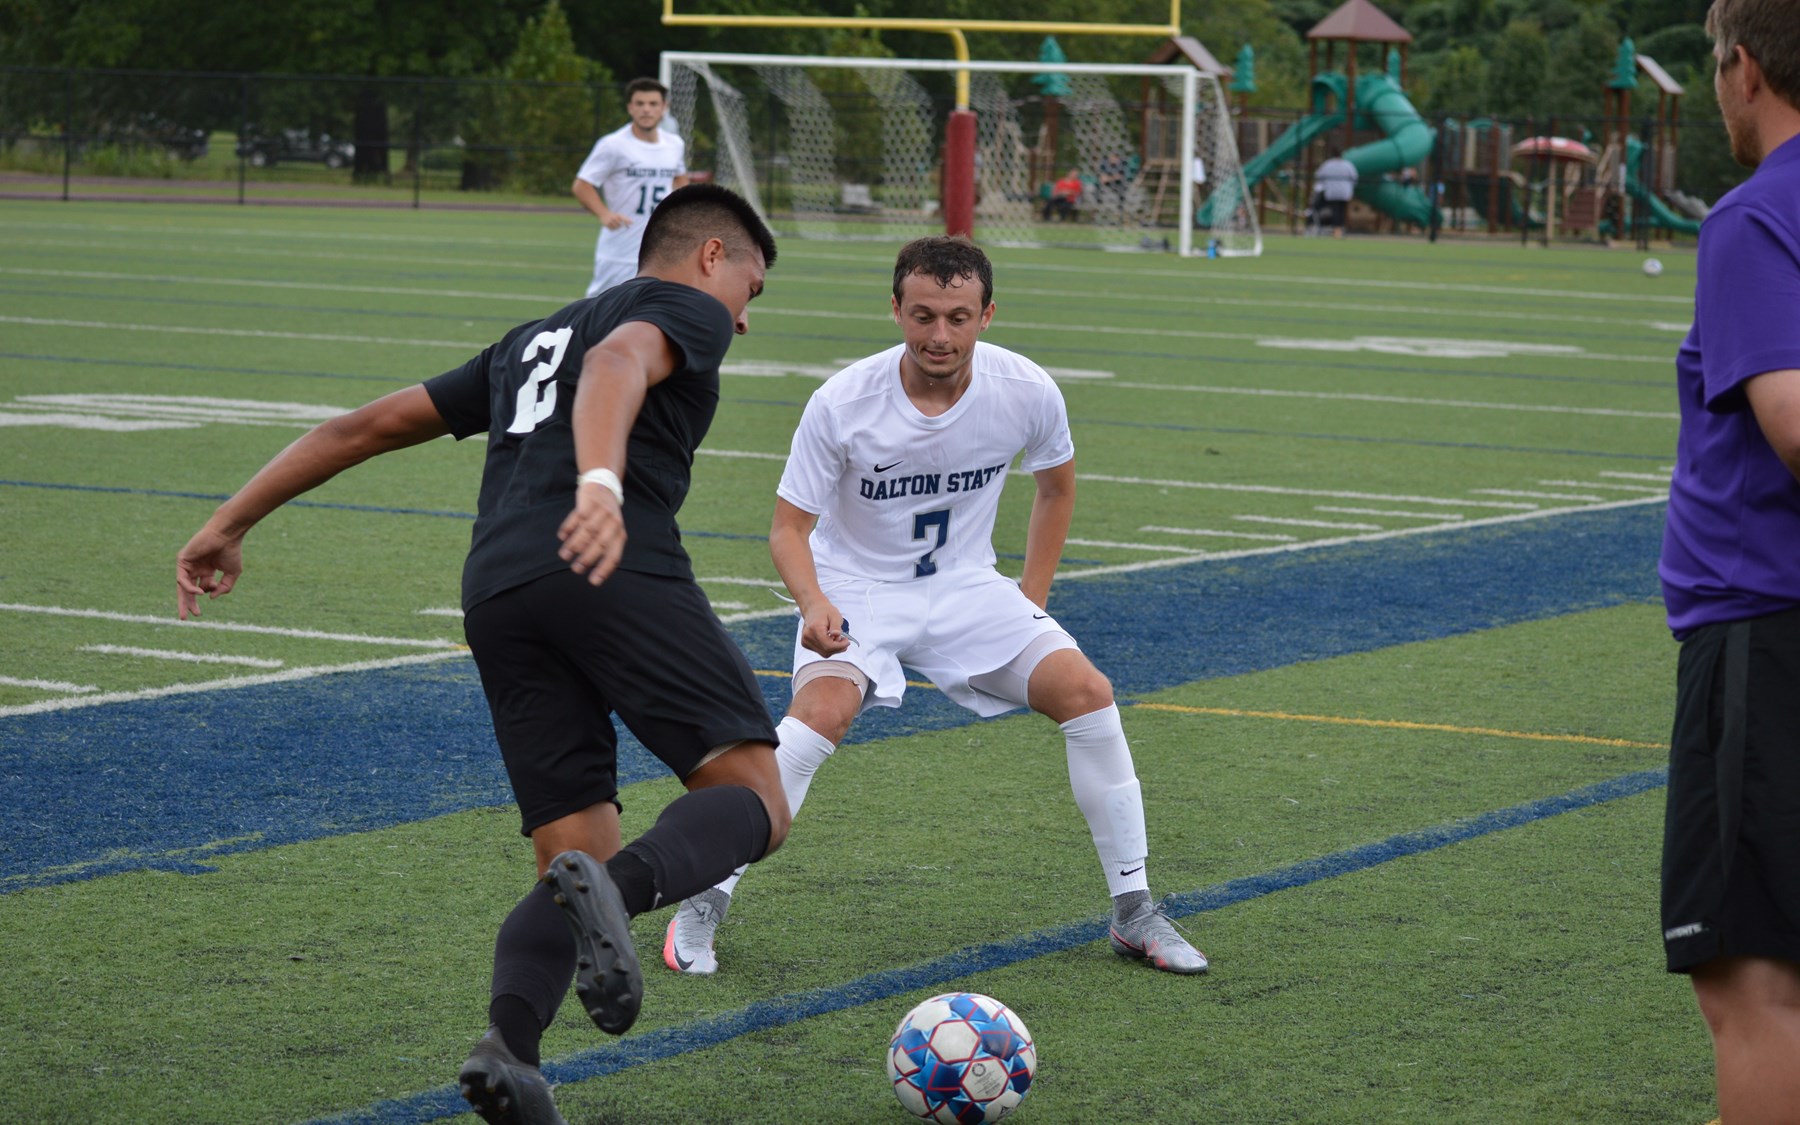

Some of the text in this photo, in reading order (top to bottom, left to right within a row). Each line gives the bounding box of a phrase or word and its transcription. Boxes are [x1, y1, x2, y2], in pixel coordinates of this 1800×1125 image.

[626, 168, 657, 177] DALTON
[506, 326, 573, 434] 2
[860, 473, 941, 500] DALTON
[912, 507, 952, 579] 7
